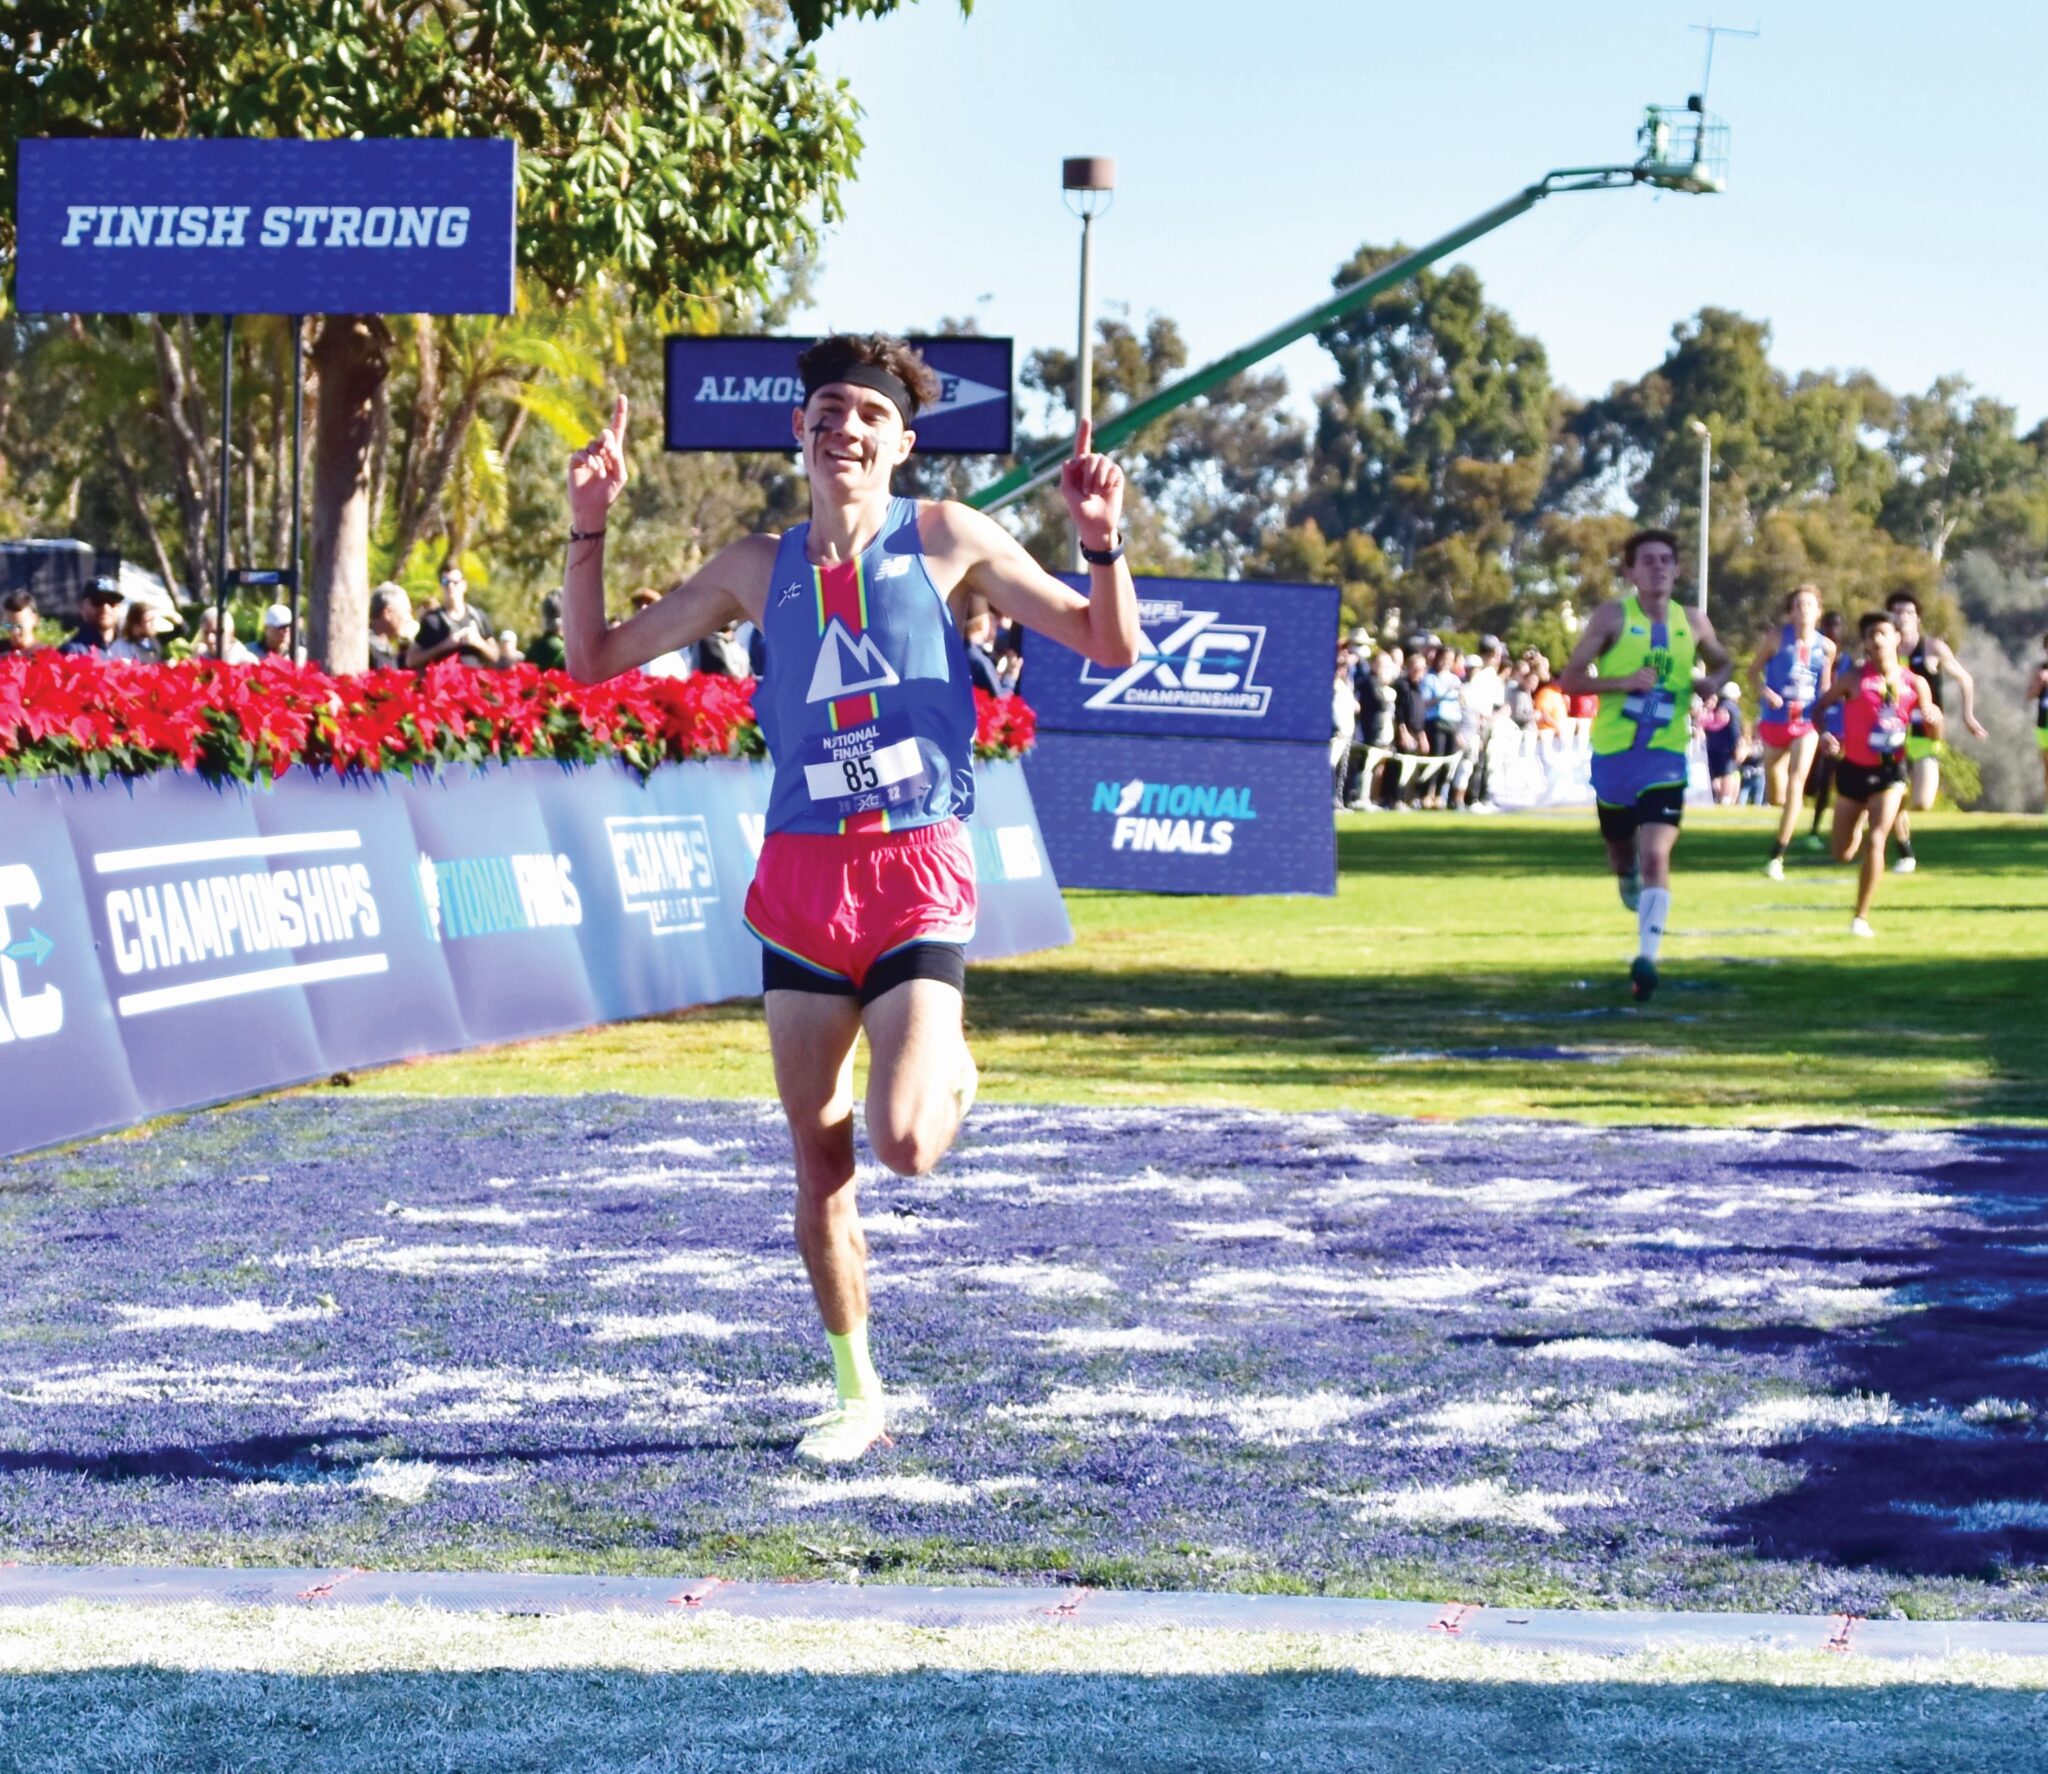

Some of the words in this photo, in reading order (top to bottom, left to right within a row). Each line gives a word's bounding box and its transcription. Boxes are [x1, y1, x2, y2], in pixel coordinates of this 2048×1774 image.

[62, 206, 250, 246] FINISH
[260, 206, 470, 247] STRONG
[694, 376, 805, 402] ALMOS
[1139, 602, 1178, 616] MPS
[1083, 611, 1251, 709] XC
[1124, 688, 1261, 709] CHAMPIONSHIPS
[833, 740, 874, 761] FINALS
[842, 755, 879, 792] 85
[1112, 817, 1235, 854] FINALS
[614, 830, 713, 895] CHAMPS
[106, 863, 381, 975] CHAMPIONSHIPS
